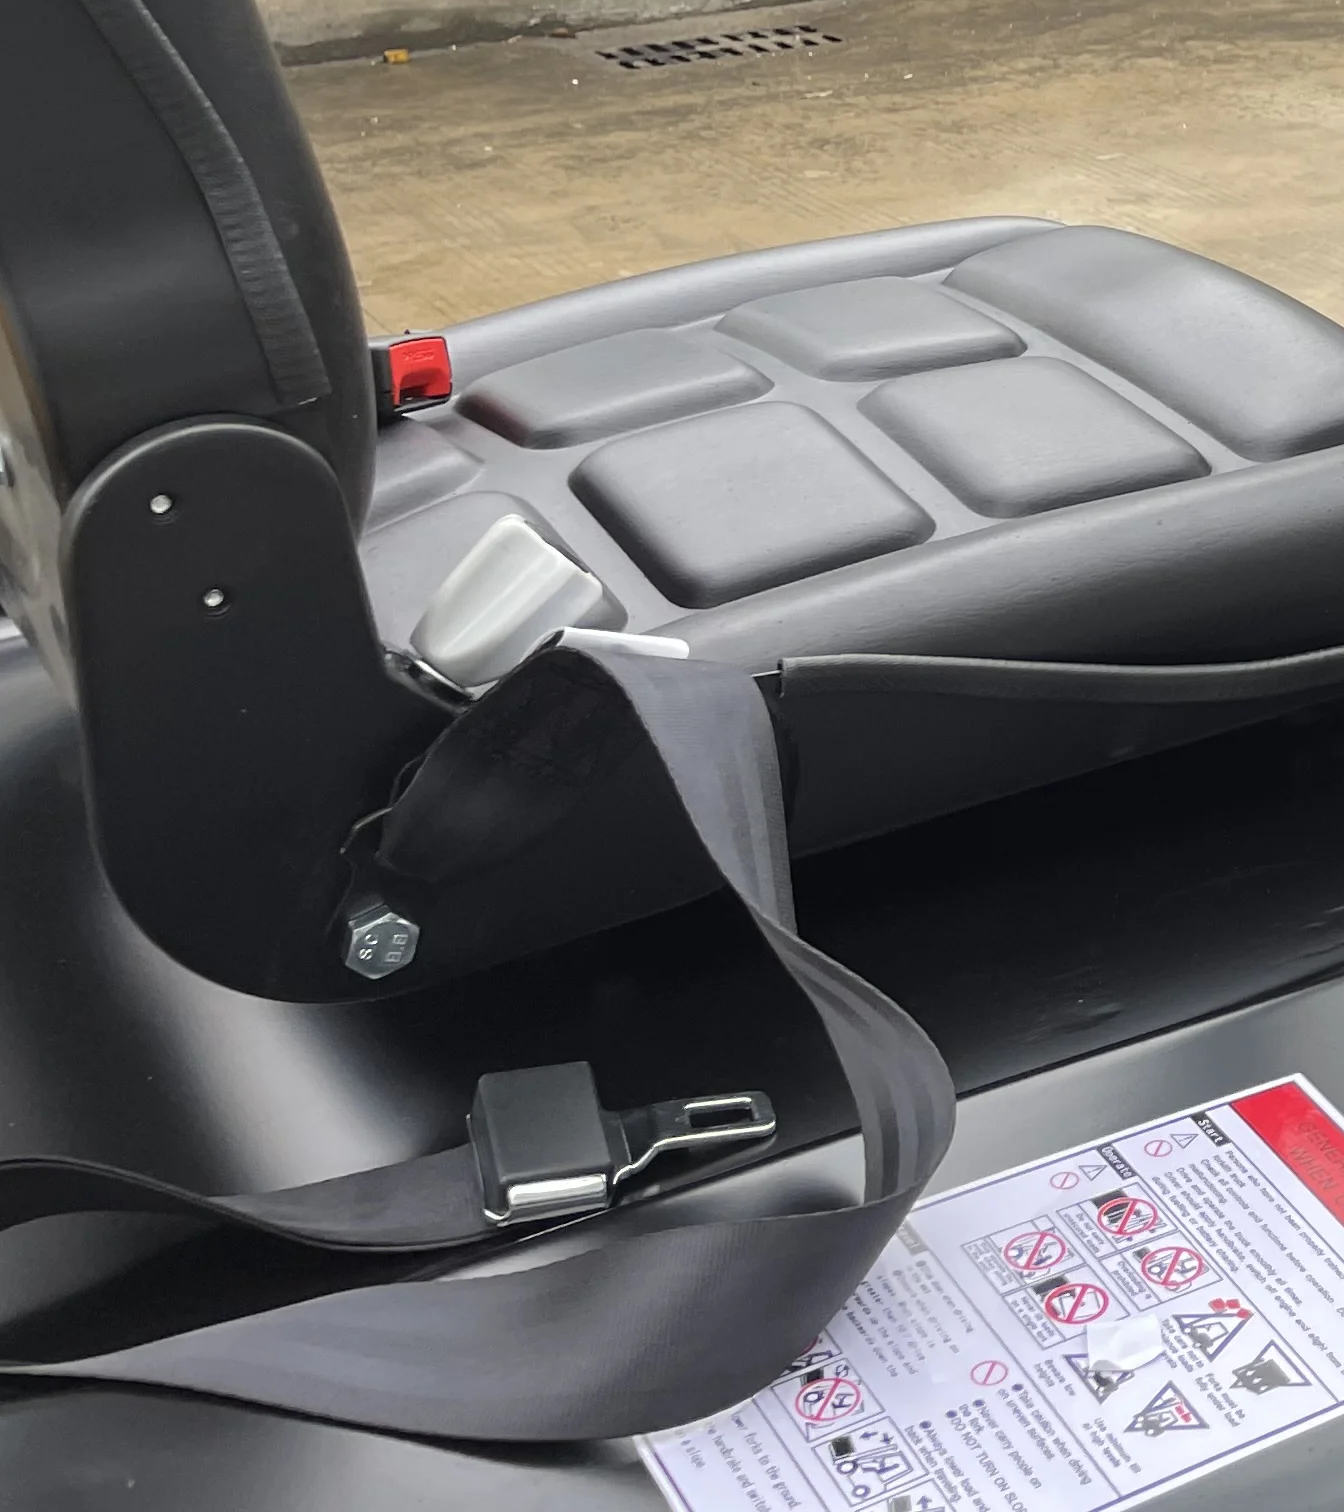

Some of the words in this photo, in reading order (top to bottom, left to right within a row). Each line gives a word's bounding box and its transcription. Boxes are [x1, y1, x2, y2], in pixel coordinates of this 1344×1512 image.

[1196, 1118, 1225, 1144] Start
[1100, 1146, 1135, 1179] Operate
[1286, 1146, 1340, 1190] WHEN
